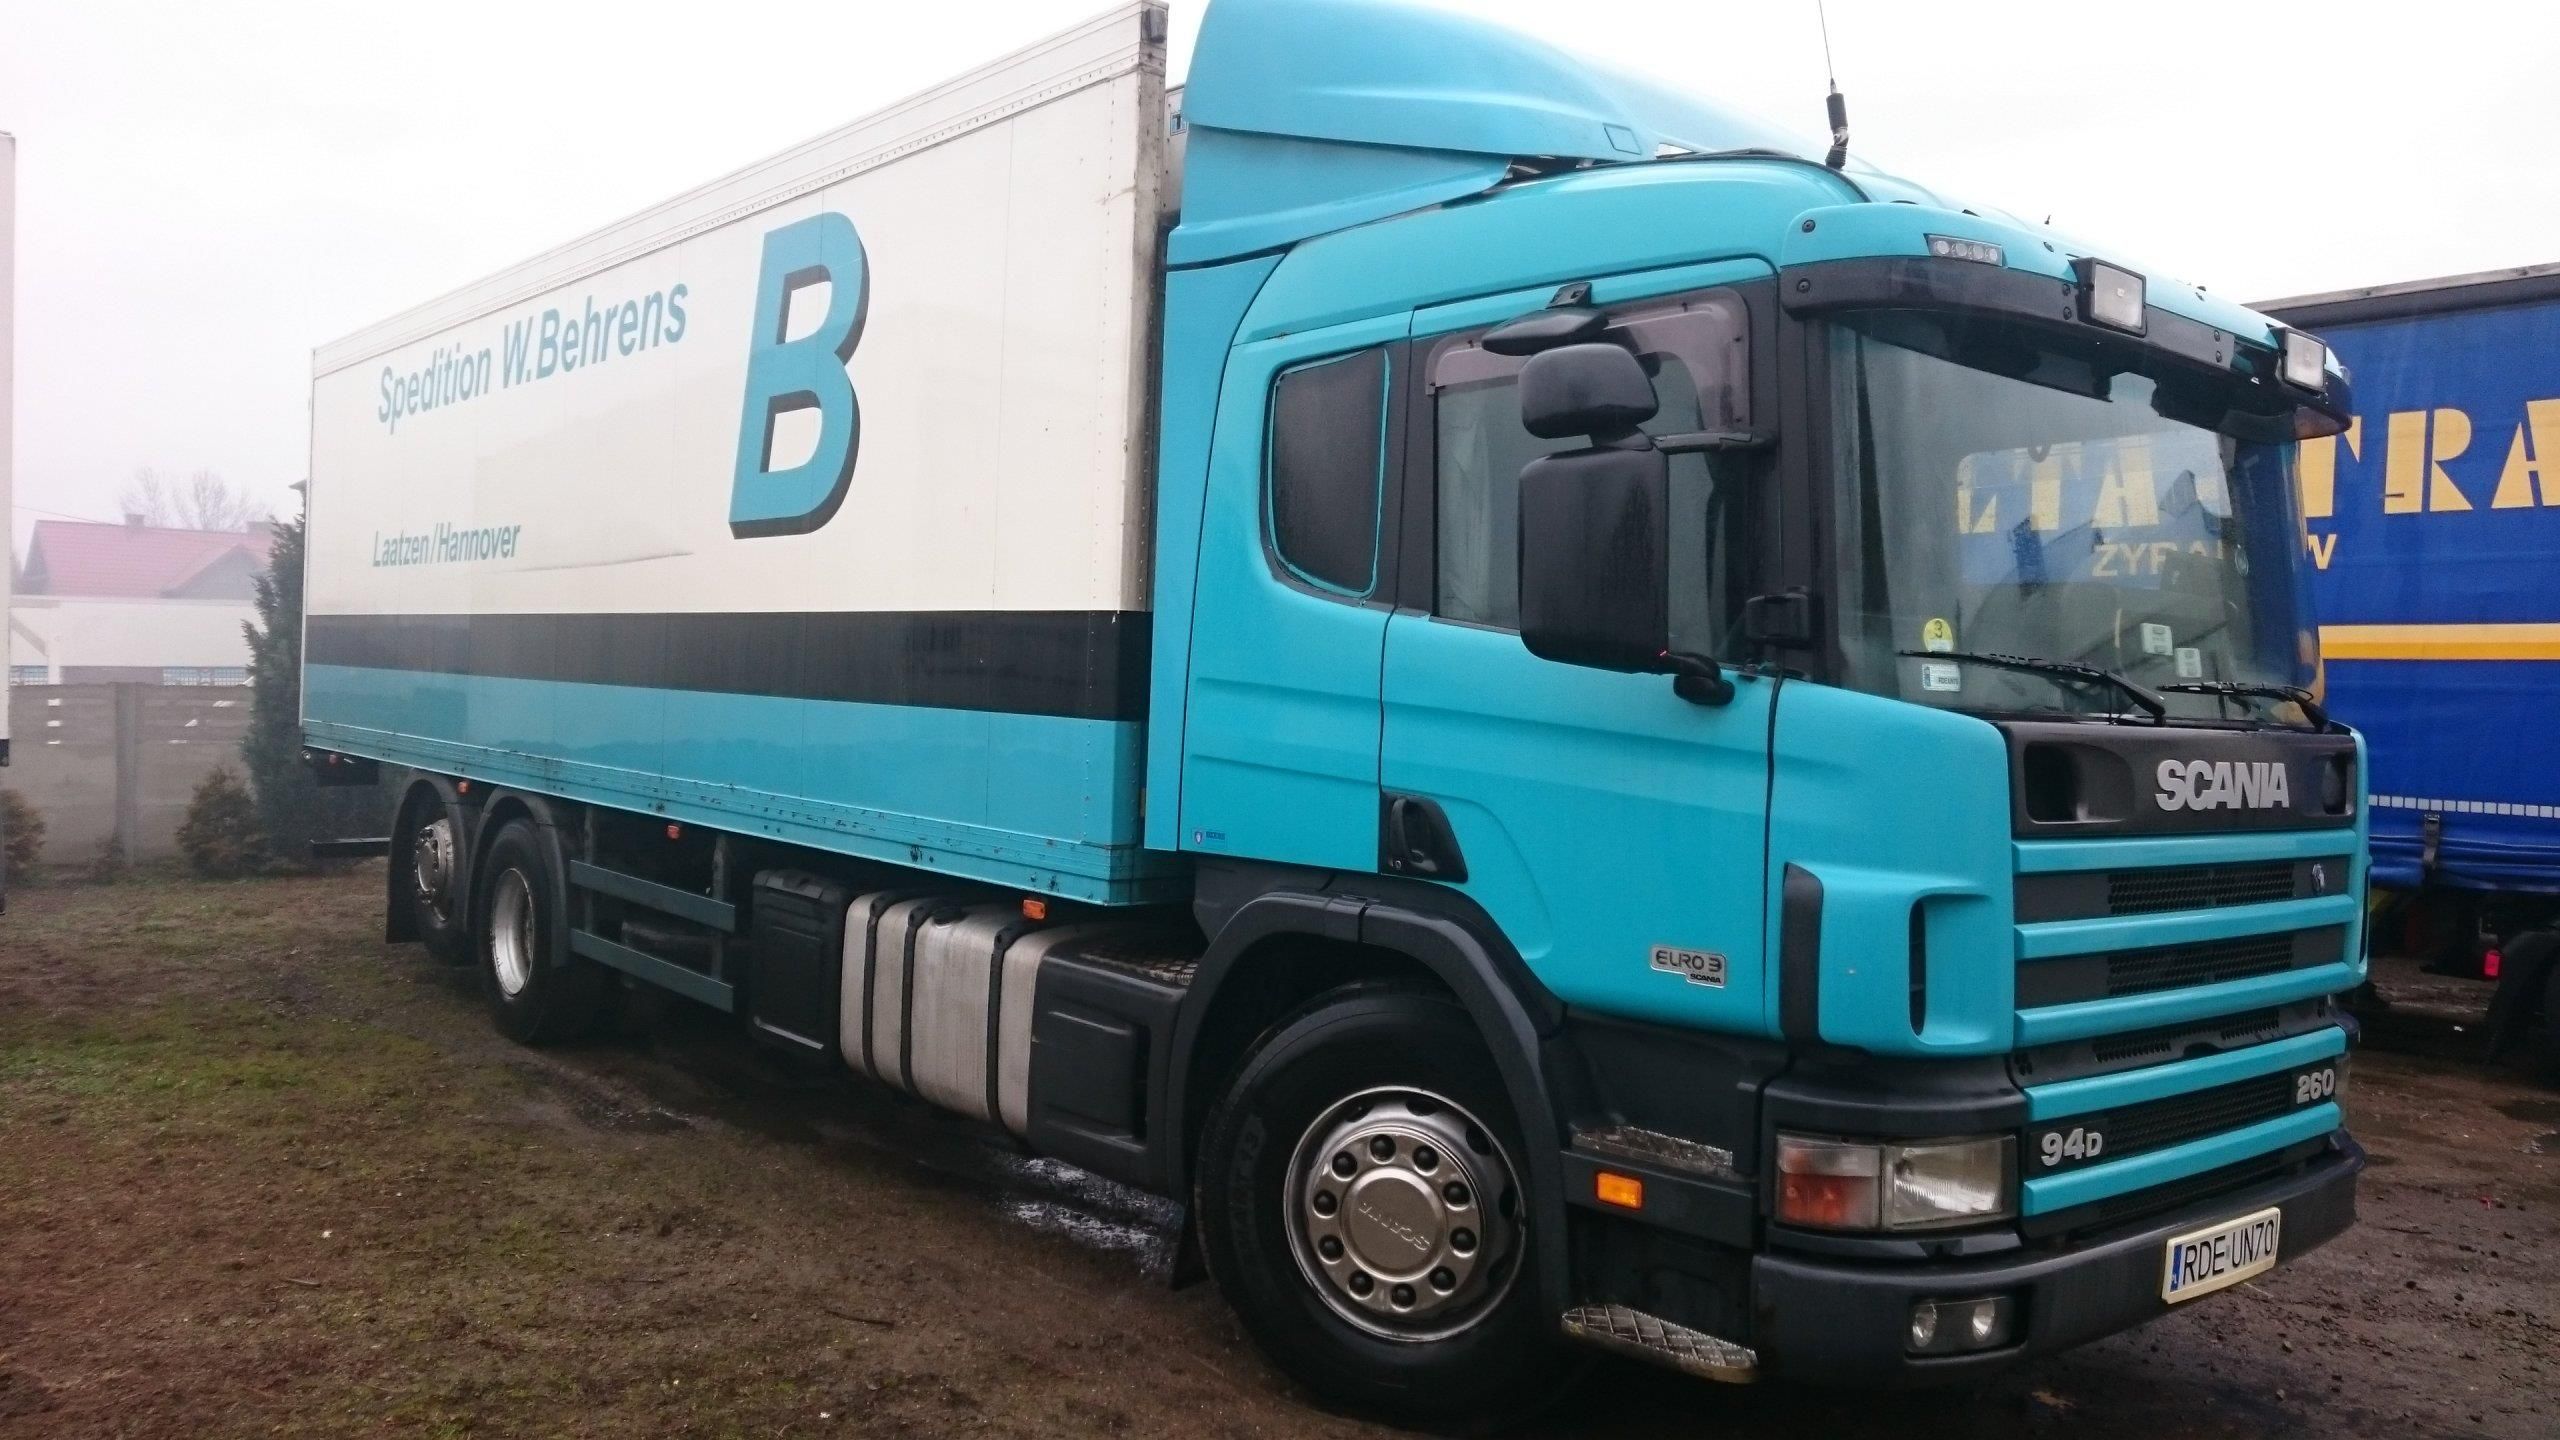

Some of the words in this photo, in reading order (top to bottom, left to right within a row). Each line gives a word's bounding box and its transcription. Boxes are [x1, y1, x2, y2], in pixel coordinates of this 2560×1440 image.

[377, 342, 492, 435] Spedition
[502, 282, 689, 389] W.Behrens
[729, 211, 870, 540] B
[372, 522, 521, 568] Laatzen/Hannover
[2155, 759, 2290, 811] SCANIA
[1656, 950, 1705, 970] EURO
[1709, 957, 1722, 972] 3
[1690, 973, 1721, 983] SCANIA
[2296, 1068, 2335, 1104] 260
[2183, 1235, 2225, 1285] RDE
[2231, 1219, 2274, 1268] UN70
